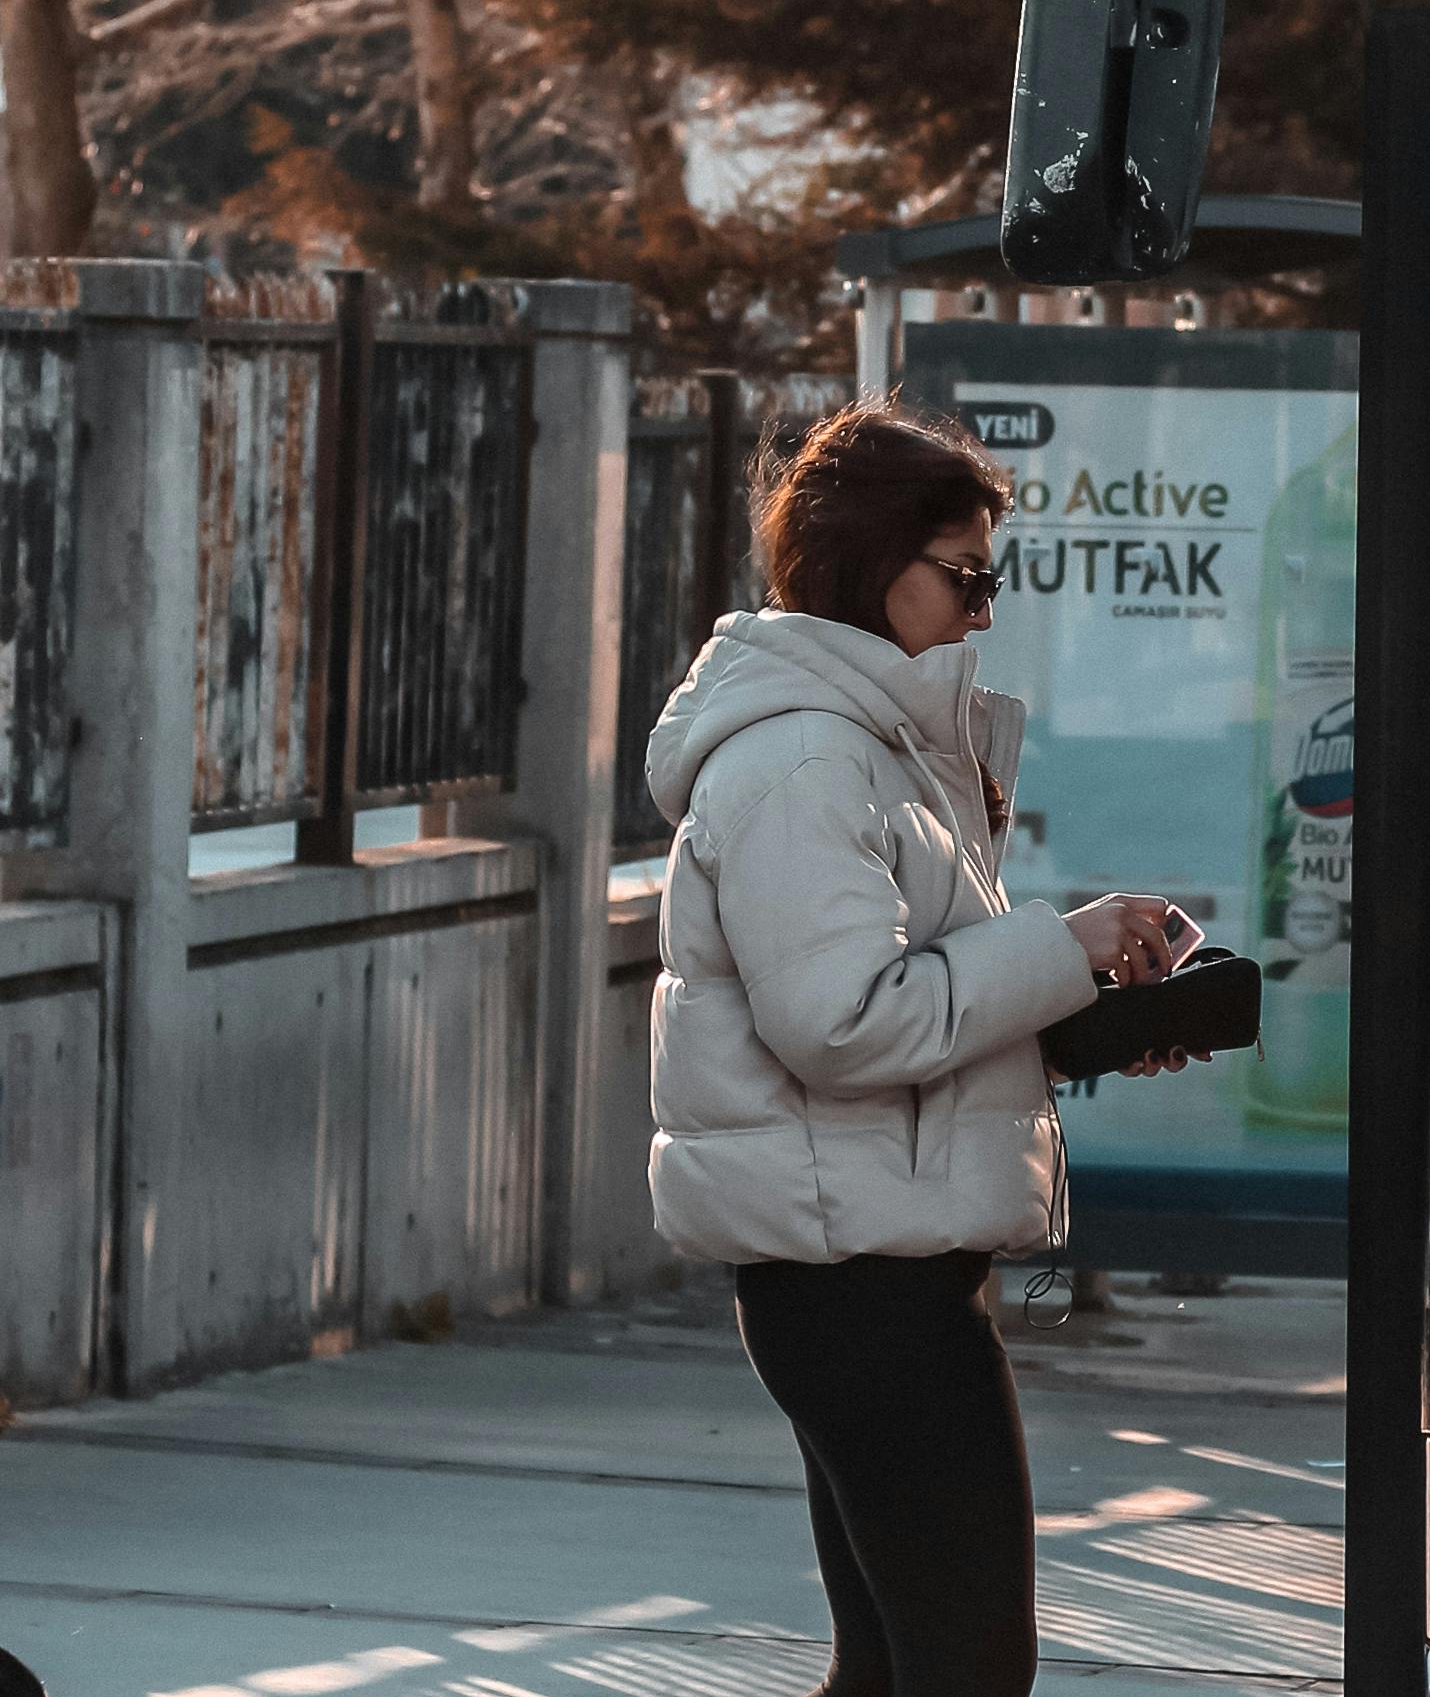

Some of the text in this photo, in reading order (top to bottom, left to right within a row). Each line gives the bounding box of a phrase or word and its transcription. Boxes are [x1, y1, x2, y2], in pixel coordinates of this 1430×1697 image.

[974, 408, 1039, 440] YENİ
[1063, 467, 1229, 519] Active
[992, 536, 1223, 598] MUTFAK
